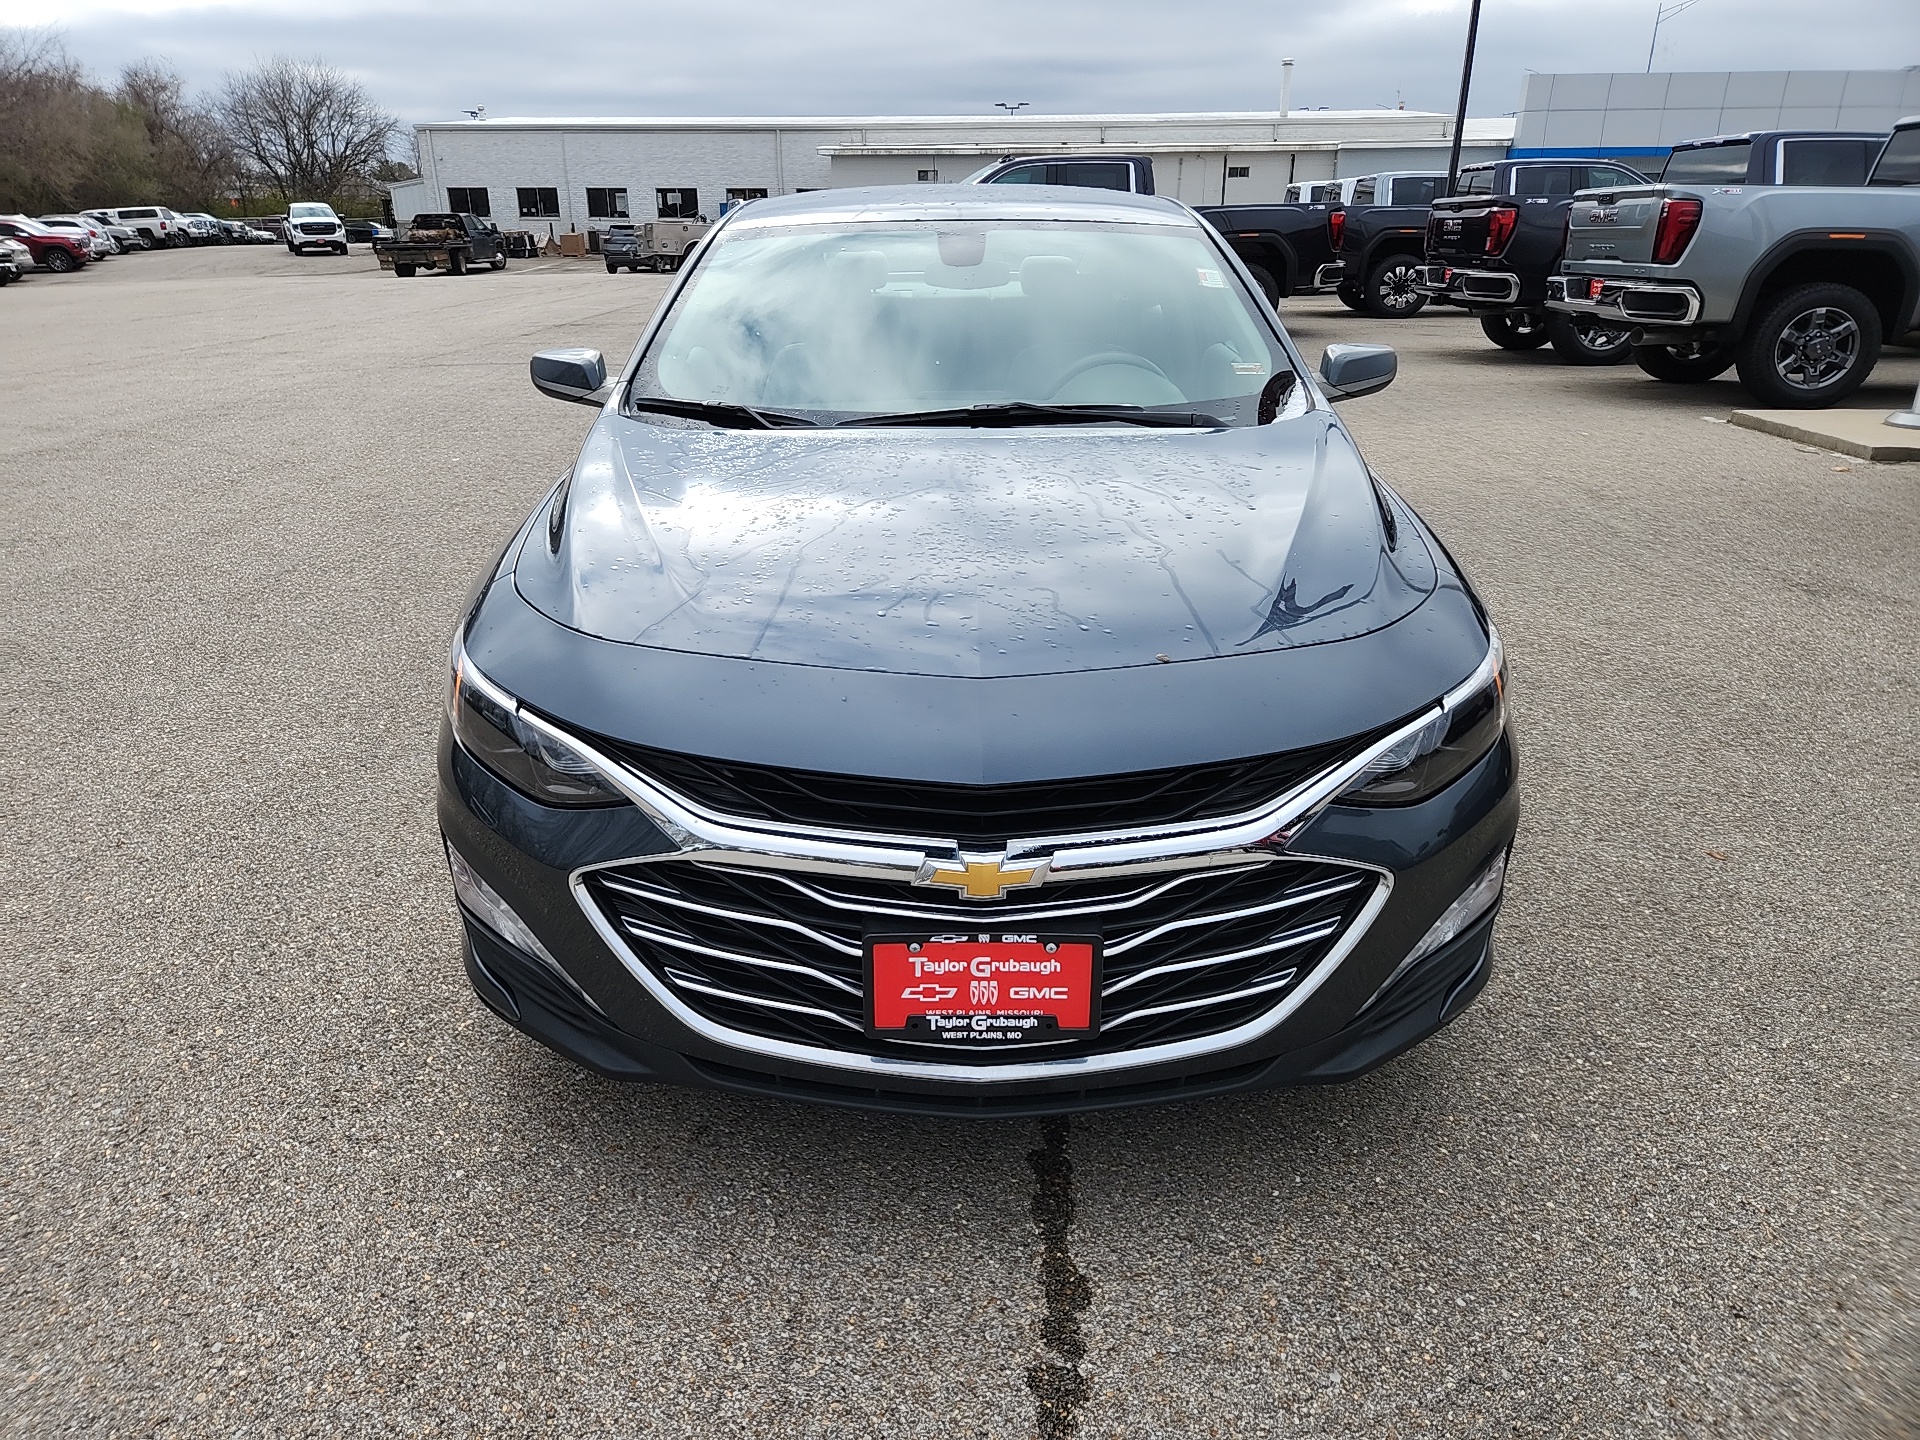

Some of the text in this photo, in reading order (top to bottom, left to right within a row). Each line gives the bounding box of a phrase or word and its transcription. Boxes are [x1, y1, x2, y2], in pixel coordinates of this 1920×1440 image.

[1001, 934, 1038, 944] GMC
[908, 956, 1061, 978] Taylor Grubaugh
[1008, 987, 1069, 1000] GMC
[925, 1015, 1038, 1031] Taylor Grubaugh
[941, 1031, 1023, 1040] WEST PLAINS, MO
